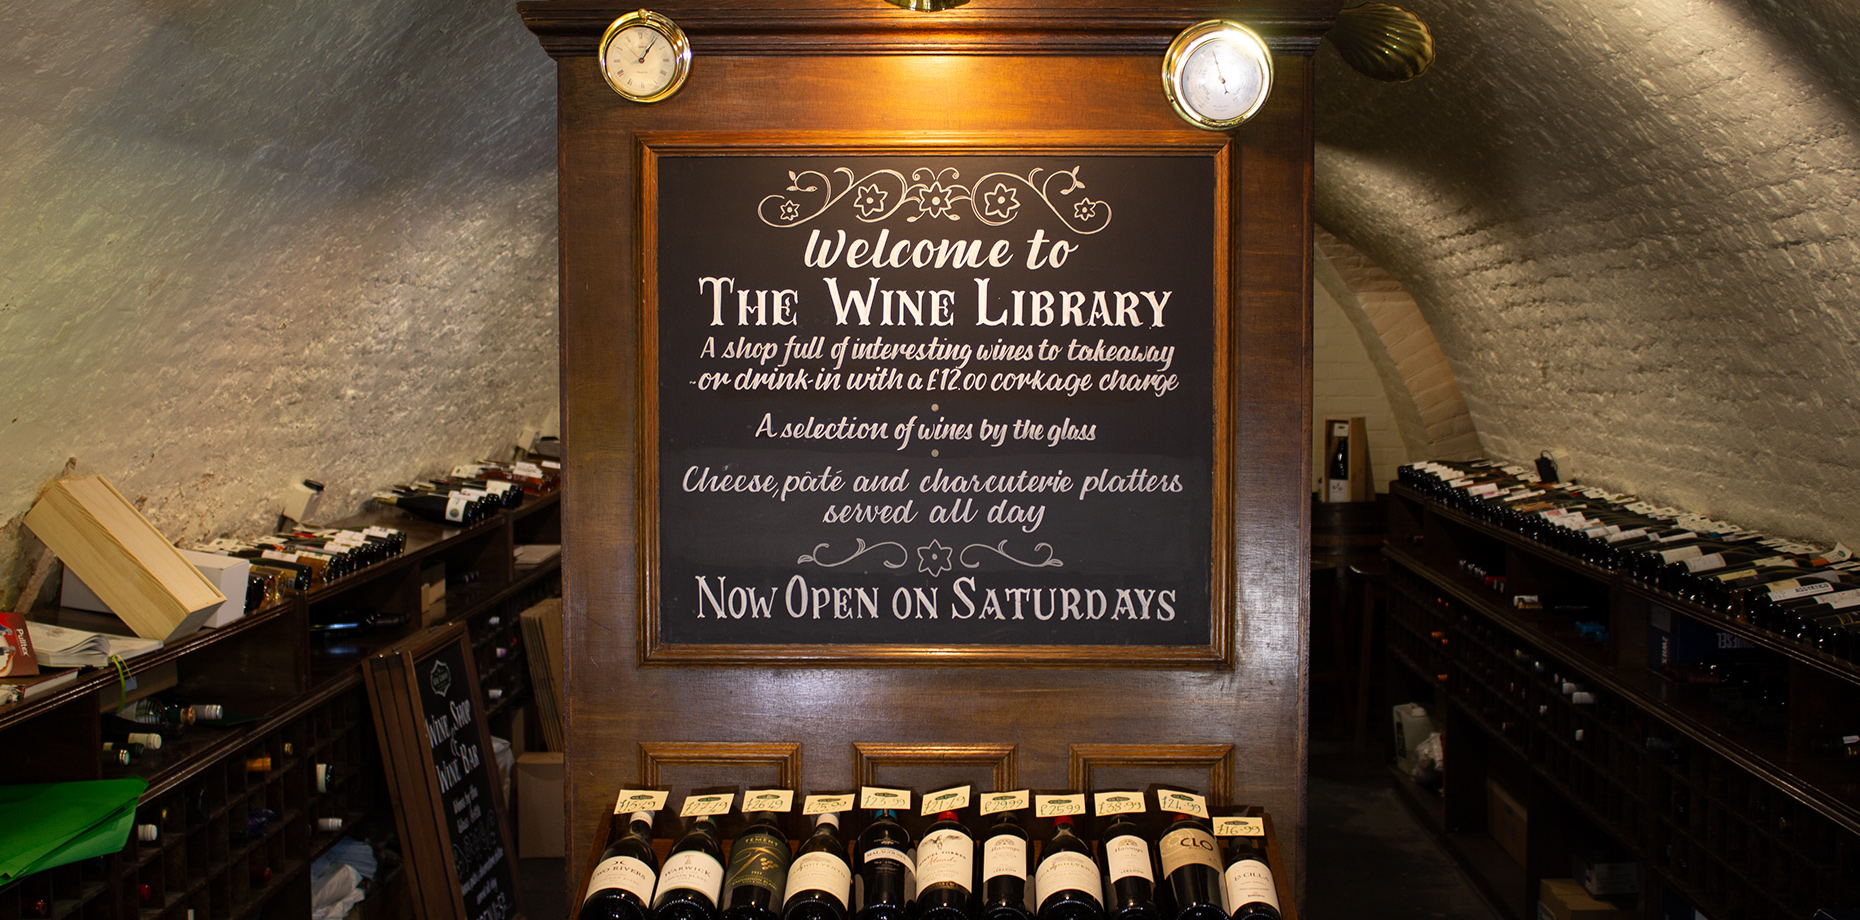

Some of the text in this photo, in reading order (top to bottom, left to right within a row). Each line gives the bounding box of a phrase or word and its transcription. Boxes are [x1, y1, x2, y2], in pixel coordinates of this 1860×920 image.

[804, 229, 1079, 271] Welcome to
[699, 276, 1172, 328] THE WINE LIBRARY
[700, 335, 1175, 372] A shop full of interesting wines to takeaway
[847, 367, 904, 391] with
[907, 373, 923, 391] a
[991, 369, 1092, 397] corkage
[1099, 369, 1180, 398] charge
[755, 413, 1097, 450] A selection of wines by the glass
[781, 465, 846, 501] pâté
[853, 468, 909, 493] and
[920, 467, 1073, 494] charcuterie
[1079, 468, 1183, 501] platters
[822, 497, 1045, 533] served all day
[695, 574, 1176, 621] NOW OPEN ON SATURDAYS
[425, 699, 472, 749] WINE SHOP
[435, 743, 481, 794] WINE BAR
[1180, 837, 1214, 852] CLO
[664, 865, 712, 878] WARWICK
